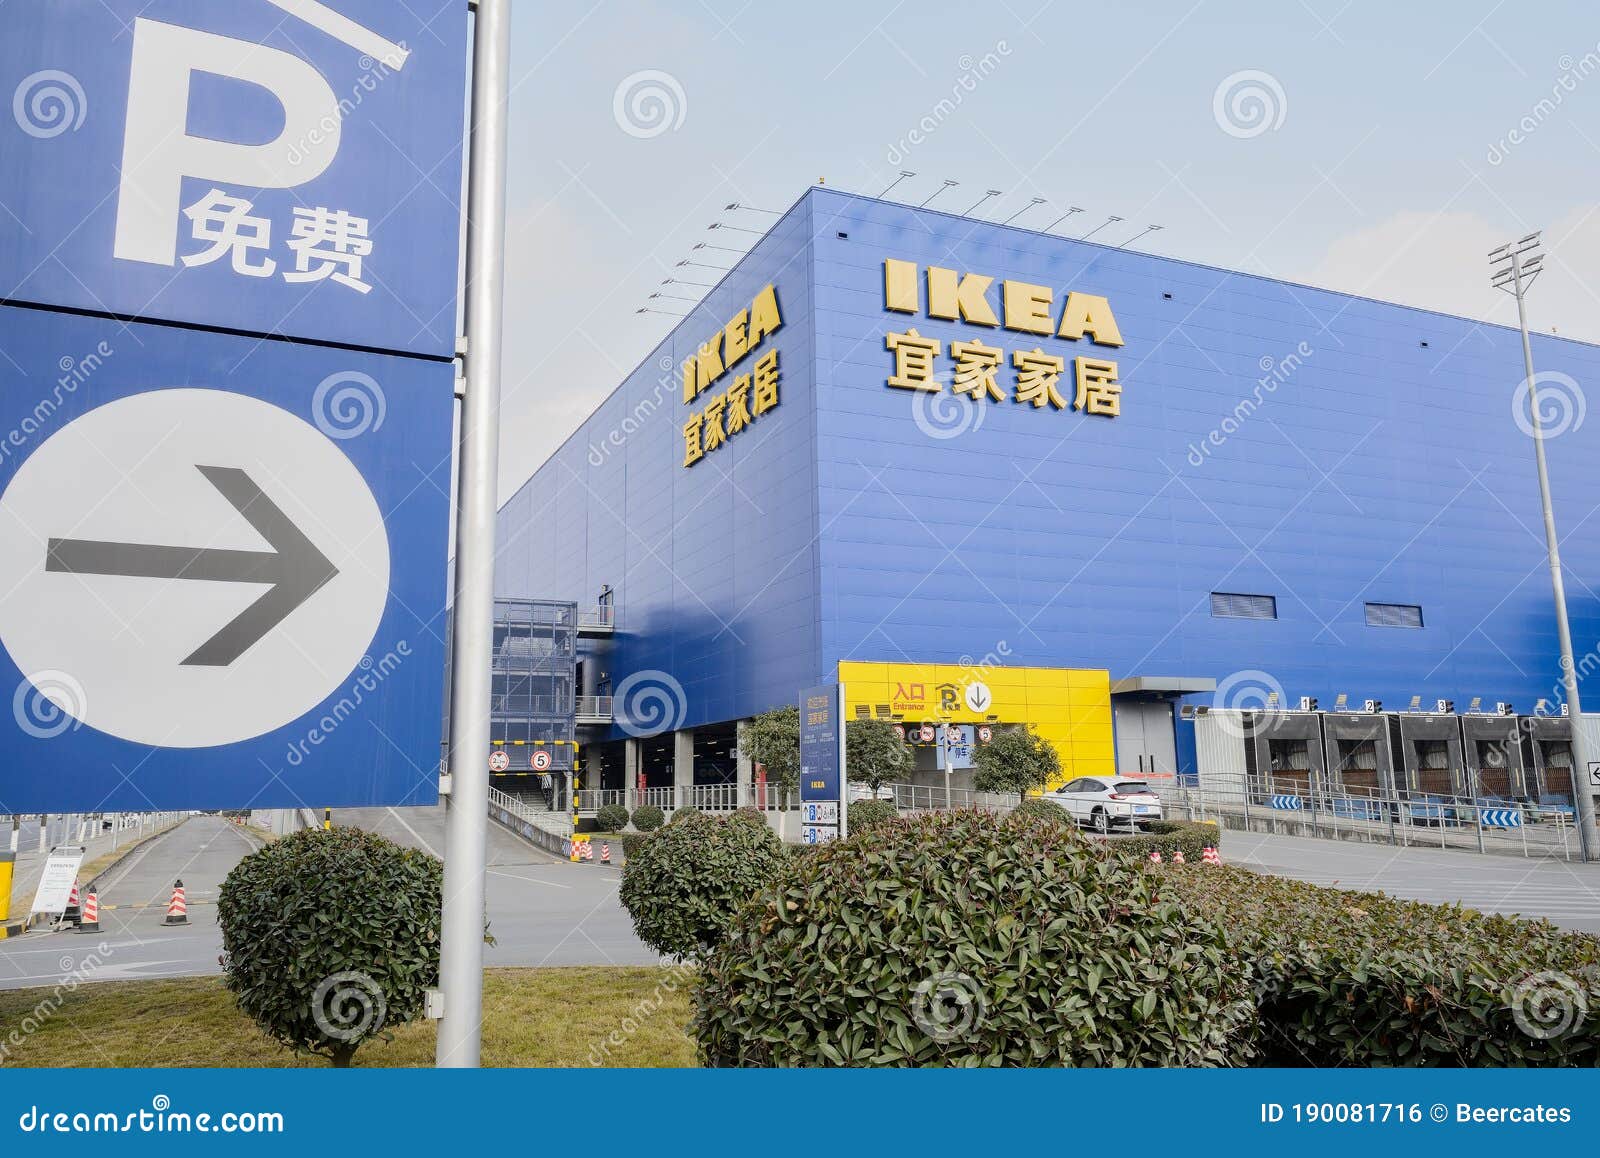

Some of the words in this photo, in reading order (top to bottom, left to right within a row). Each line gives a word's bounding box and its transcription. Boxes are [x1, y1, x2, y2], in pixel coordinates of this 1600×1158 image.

[113, 17, 342, 267] P
[179, 188, 374, 294] 免费
[884, 258, 1125, 347] IKEA
[683, 283, 783, 405] IKEA
[885, 328, 1123, 417] 宜家家居
[682, 348, 780, 469] 宜家家居
[893, 682, 925, 701] 入口
[893, 702, 925, 711] Entrance
[1303, 698, 1308, 708] 1
[1367, 702, 1373, 711] 2
[1439, 701, 1445, 711] 3
[1498, 704, 1504, 712] 4
[1562, 705, 1568, 714] 5
[537, 755, 545, 767] 5
